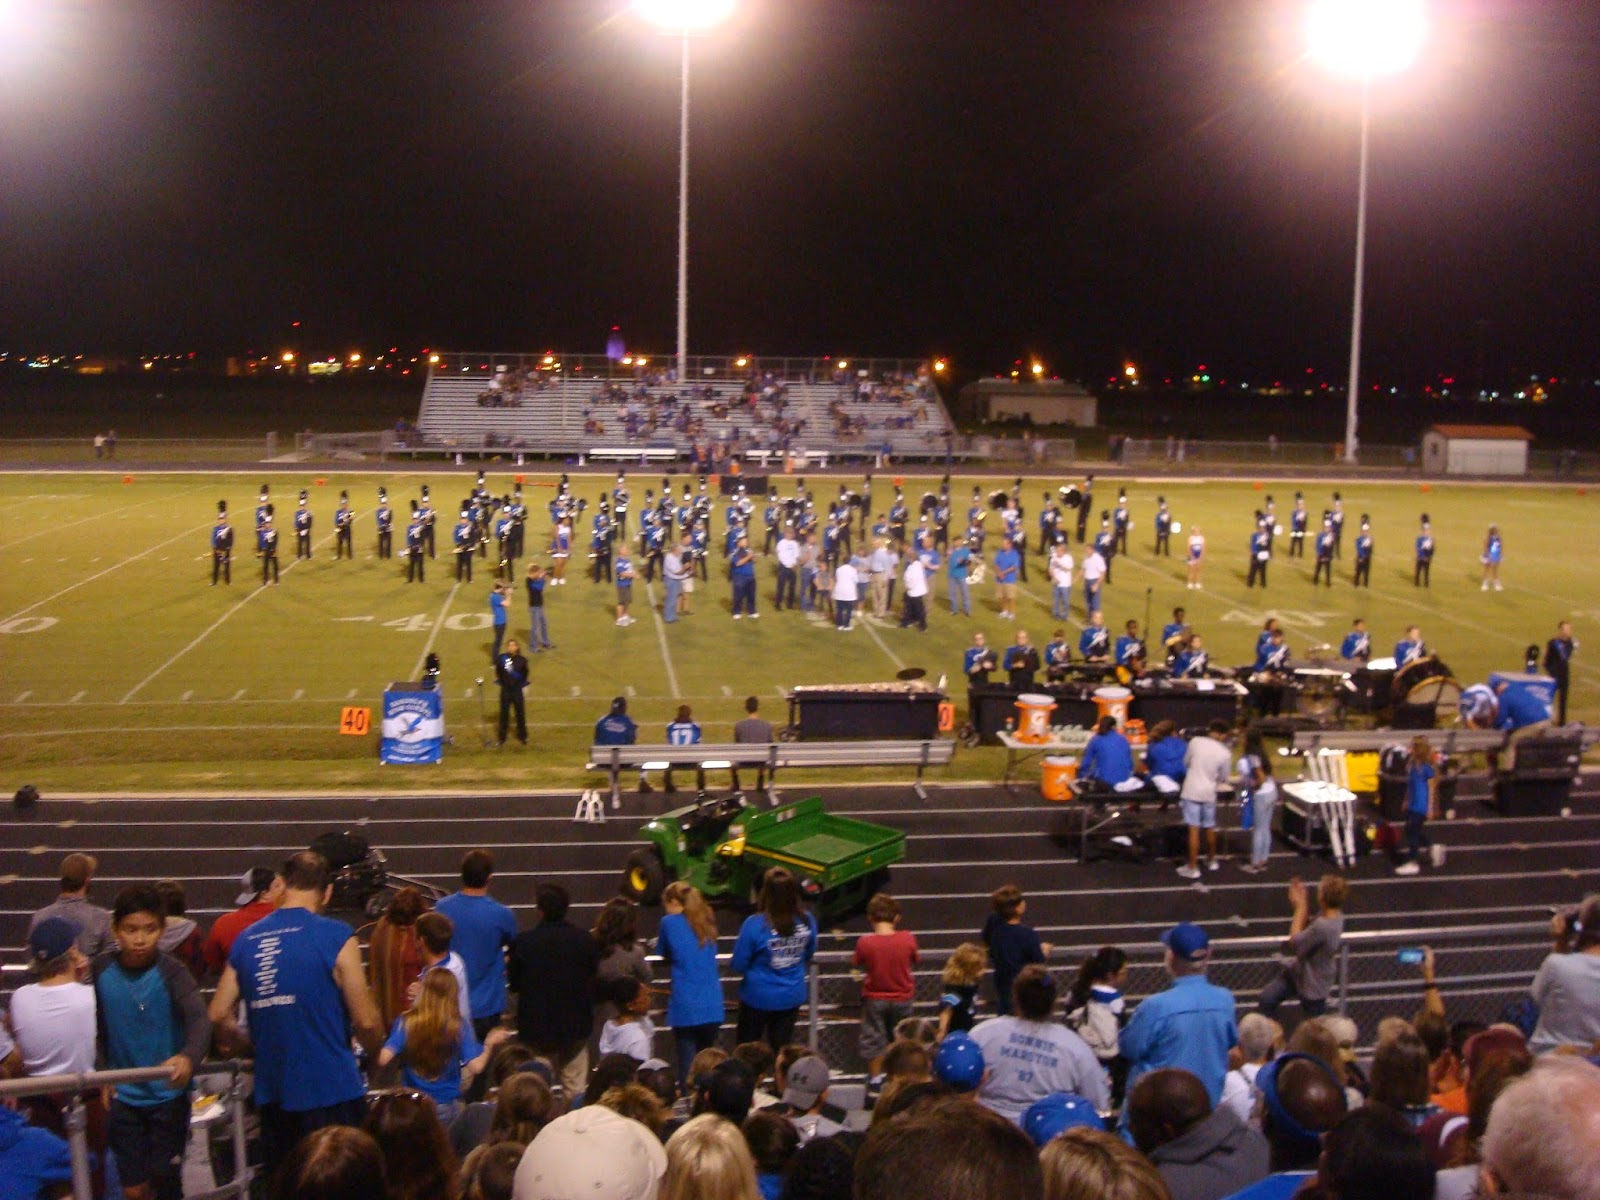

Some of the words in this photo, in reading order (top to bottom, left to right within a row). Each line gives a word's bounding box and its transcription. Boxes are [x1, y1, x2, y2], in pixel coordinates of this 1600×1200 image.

[381, 613, 495, 631] 40
[344, 708, 365, 731] 40
[671, 728, 693, 746] 17
